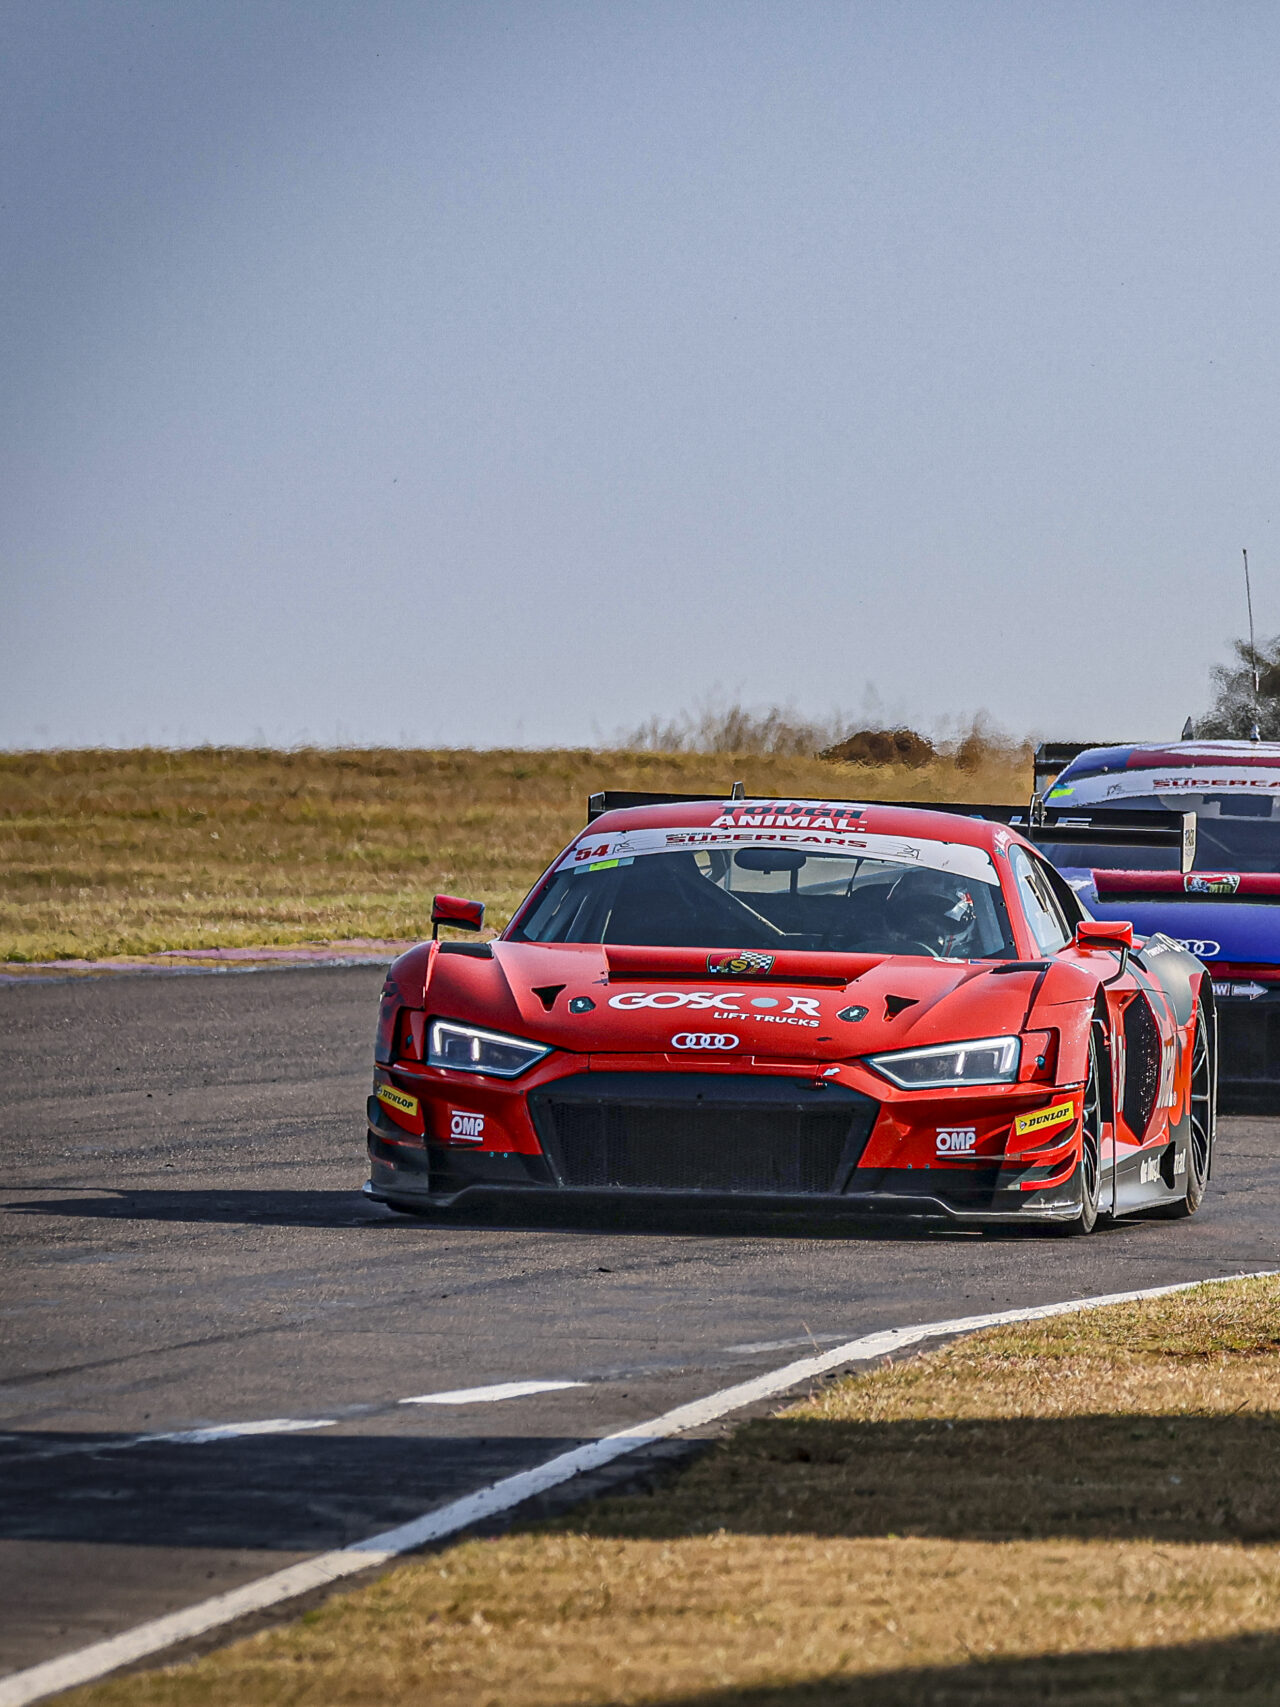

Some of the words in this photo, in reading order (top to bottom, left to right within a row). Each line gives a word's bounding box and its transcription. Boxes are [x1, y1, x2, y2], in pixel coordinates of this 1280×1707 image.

[719, 806, 864, 819] TOUGH
[665, 834, 868, 849] SUPERCARS
[575, 844, 610, 862] 54
[713, 1011, 750, 1020] LIFT
[754, 1014, 821, 1028] TRUCKS
[382, 1089, 414, 1109] DUNLOP
[451, 1115, 485, 1137] OMP
[1028, 1107, 1070, 1127] DUNLOP
[936, 1131, 976, 1151] OMP
